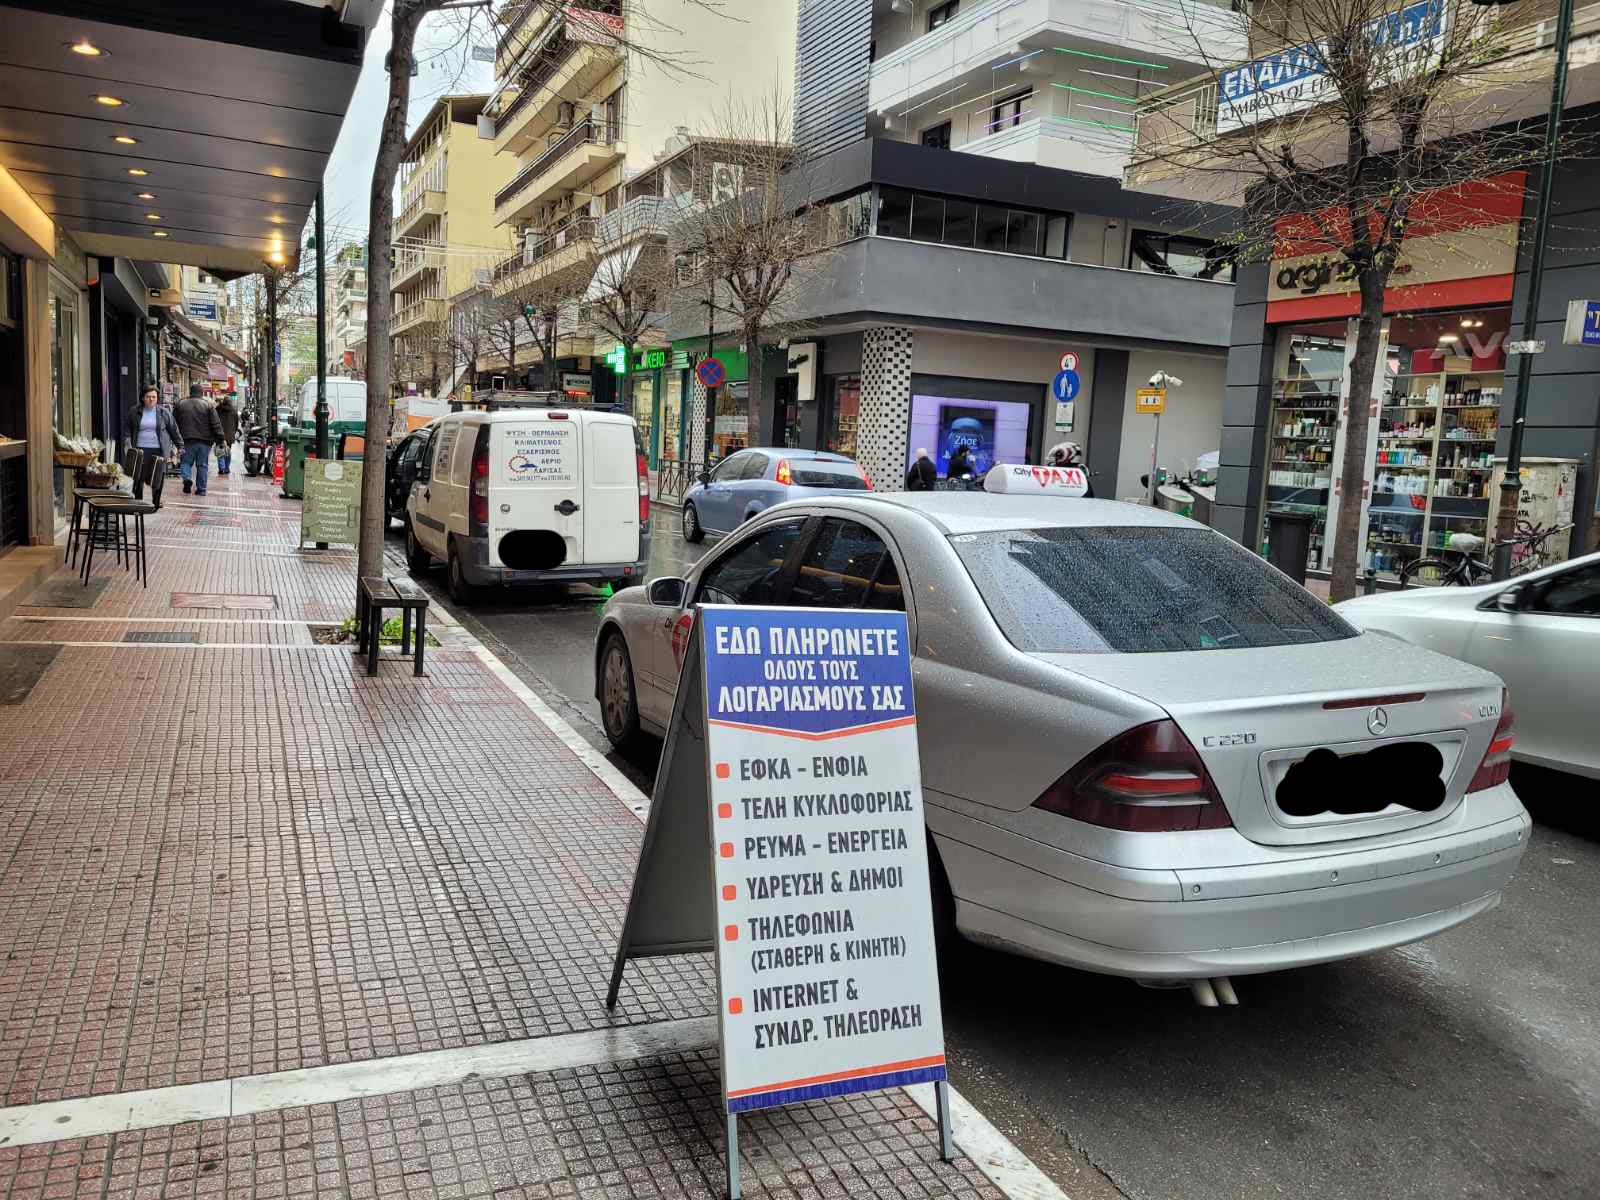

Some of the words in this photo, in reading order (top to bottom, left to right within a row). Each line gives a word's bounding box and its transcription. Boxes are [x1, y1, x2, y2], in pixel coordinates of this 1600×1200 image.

[1031, 466, 1083, 488] TAXI
[715, 626, 761, 655] ΕΔΩ
[769, 627, 900, 656] ΠΛΗΡΩΝΕΤΕ
[764, 659, 817, 681] ΟΛΟΥΣ
[819, 660, 859, 681] ΤΟΥΣ
[718, 685, 867, 713] ΛΟΓΑΡΙΑΣΜΟΥΣ
[871, 685, 905, 711] ΣΑΣ
[1219, 732, 1257, 746] 220
[739, 758, 792, 781] ΕΦΚΑ
[812, 755, 868, 779] ΕΝΦΙΑ
[741, 796, 788, 820] ΤΕΛΗ
[793, 790, 914, 818] ΚΥΚΛΟΦΟΡΙΑΣ
[744, 834, 807, 861] ΡΕΥΜΑ
[827, 828, 909, 854] ΕΝΕΡΓΕΙΑ
[745, 871, 824, 901] ΥΔΡΕΥΣΗ
[831, 870, 843, 893] &
[849, 866, 904, 892] ΔΗΜΟΙ
[747, 909, 855, 942] ΤΗΛΕΦΩΝΙΑ
[750, 943, 825, 974] (ΣΤΑΘΕΡΗ
[829, 942, 841, 963] &
[845, 935, 907, 961] ΚΙΝΗΤΗ)
[752, 979, 839, 1014] INTERNET
[845, 977, 859, 1001] &
[755, 1018, 819, 1050] ΣΥΝΔΡ.
[823, 1003, 923, 1040] ΤΗΛΕΟΡΑΣΗ
